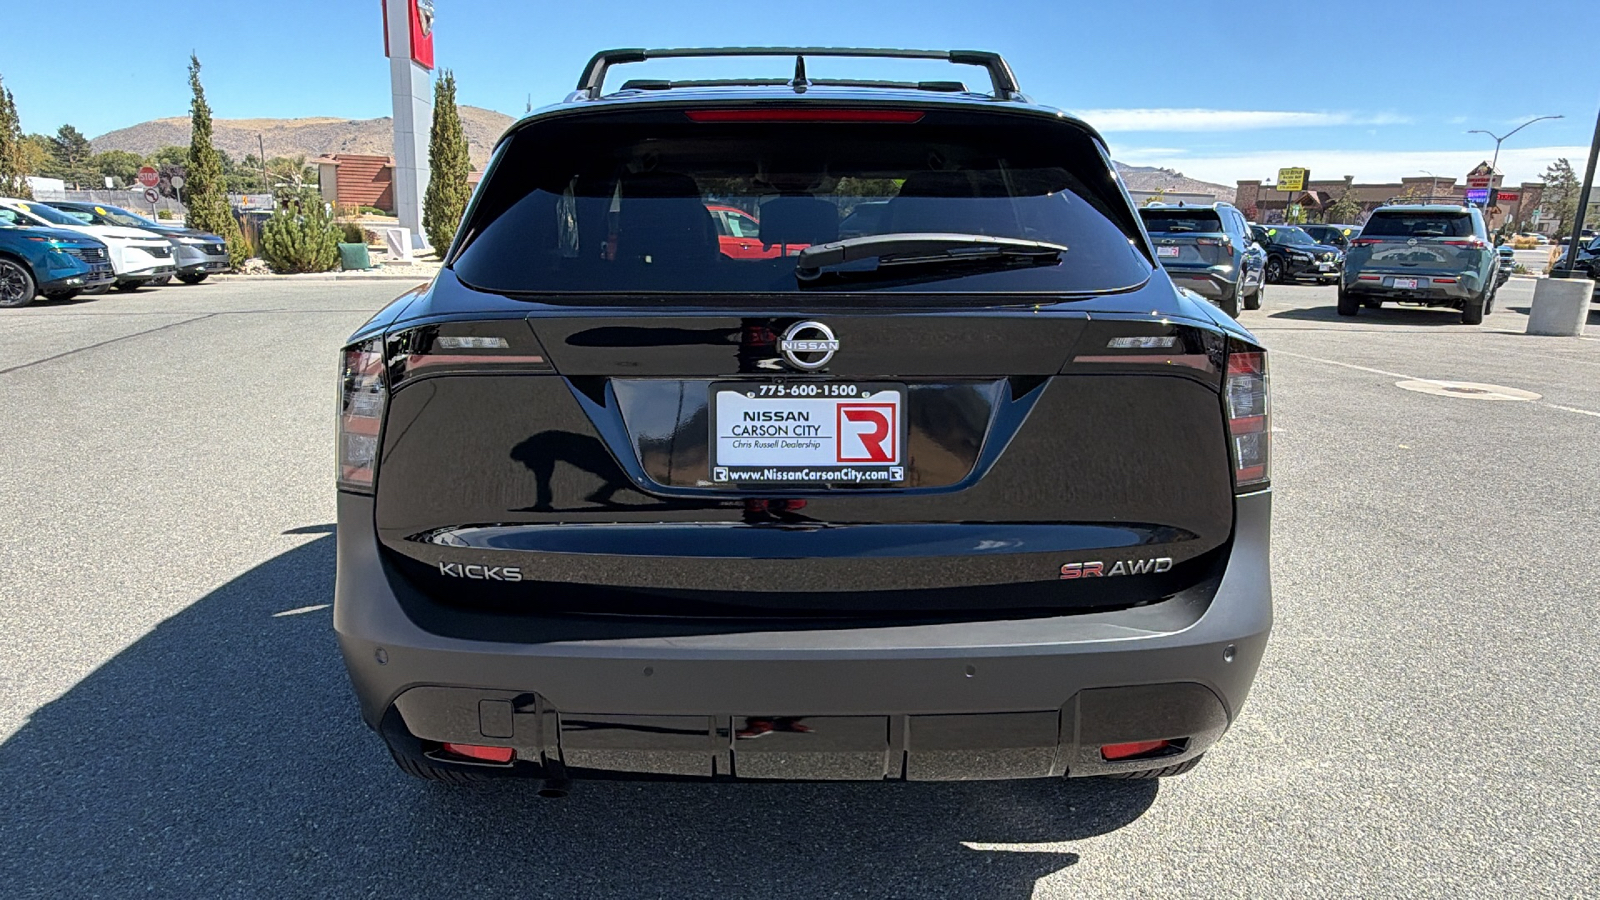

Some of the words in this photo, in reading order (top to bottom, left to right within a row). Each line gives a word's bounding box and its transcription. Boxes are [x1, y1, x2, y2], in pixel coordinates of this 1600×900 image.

[782, 341, 838, 350] NISSAN
[759, 385, 857, 396] 775-600-1500
[743, 411, 810, 422] NISSAN
[731, 425, 789, 436] CARSON
[793, 425, 821, 436] CITY
[732, 440, 752, 449] Chris
[754, 440, 779, 449] Russell
[780, 440, 821, 450] Dealership
[729, 468, 888, 482] www.NissanCarsonCity.com
[439, 562, 523, 582] KICKS
[1060, 561, 1104, 579] SR
[1107, 557, 1173, 577] AWD
